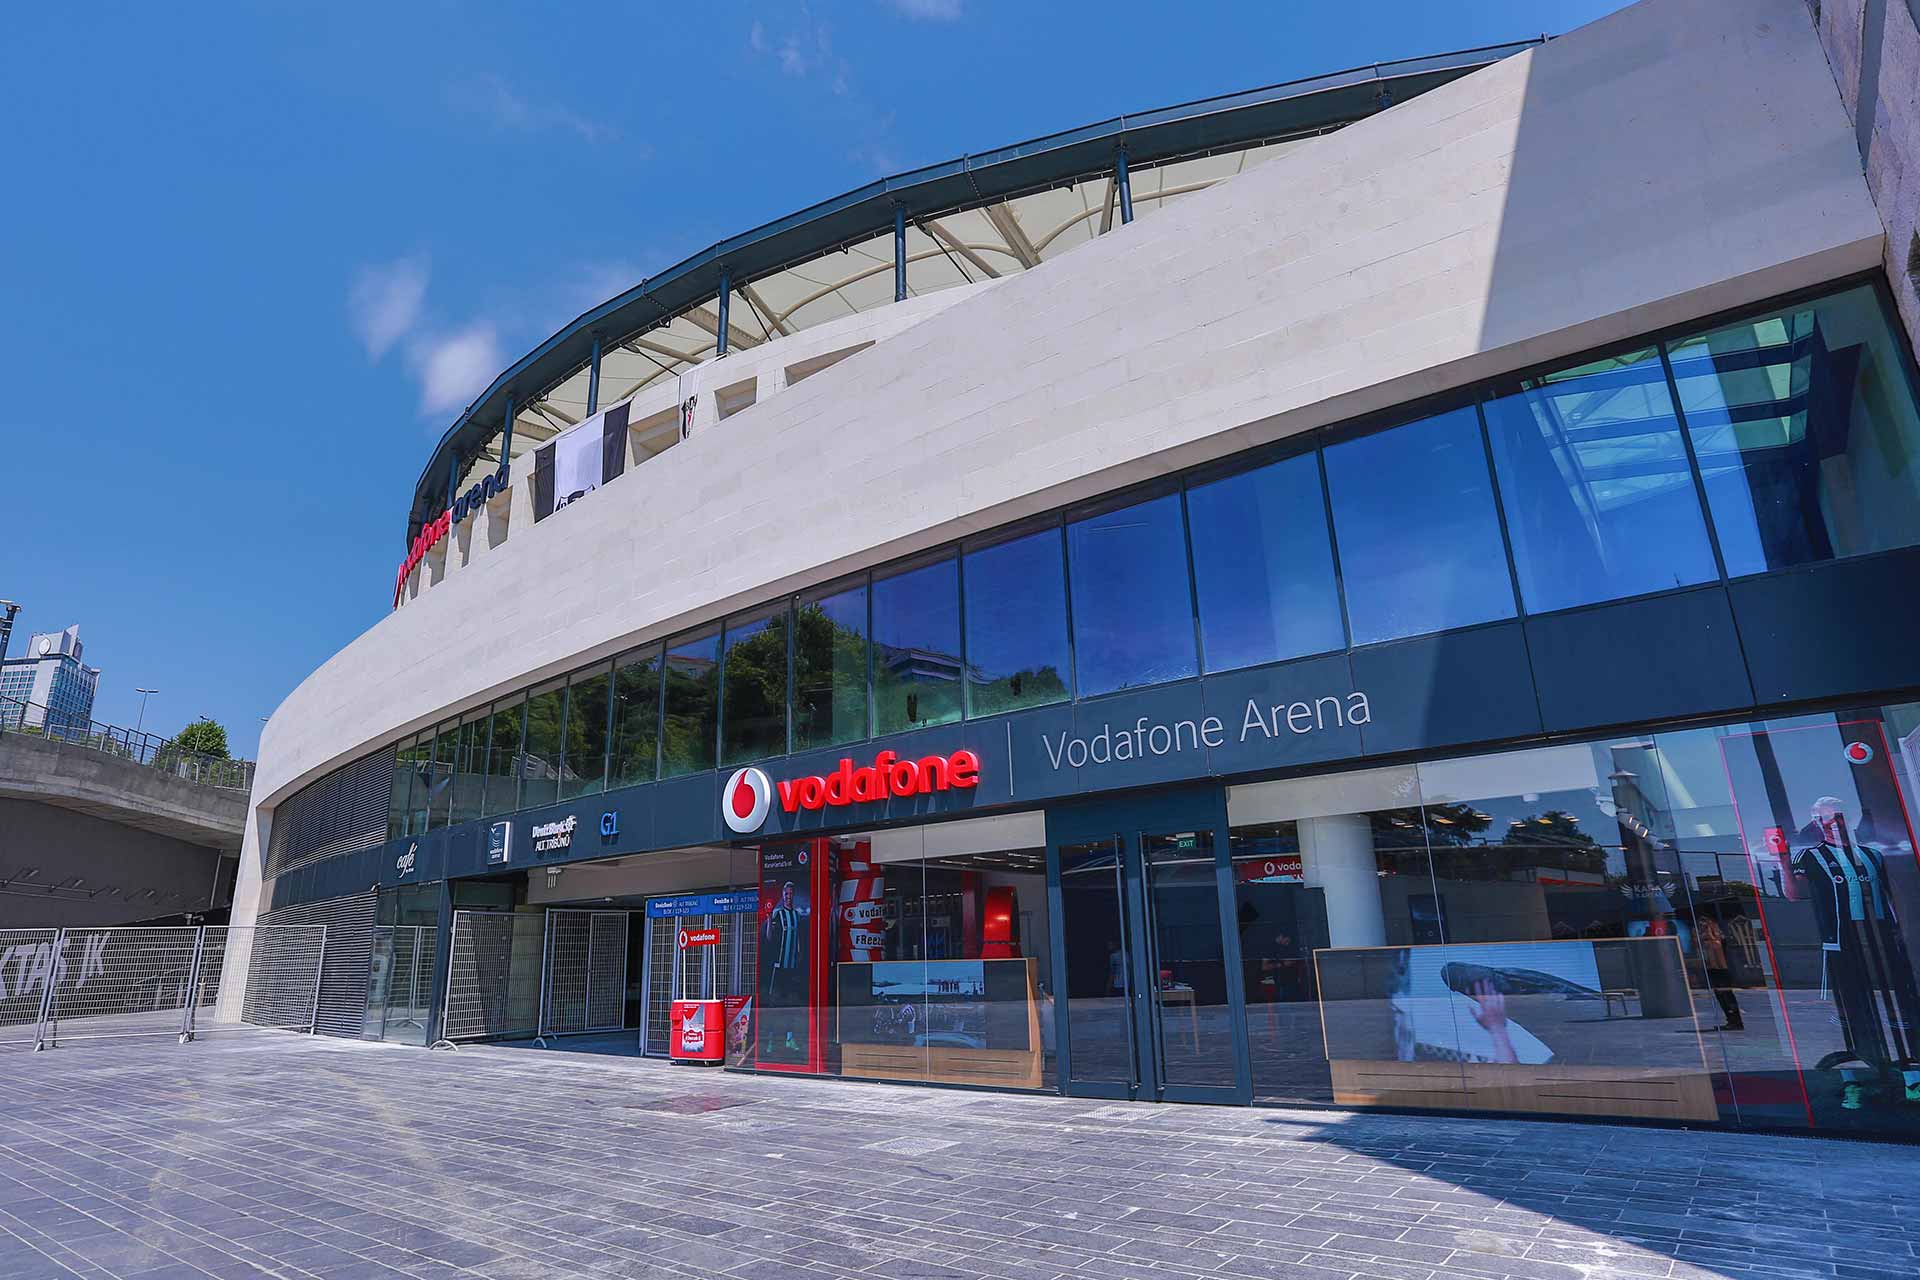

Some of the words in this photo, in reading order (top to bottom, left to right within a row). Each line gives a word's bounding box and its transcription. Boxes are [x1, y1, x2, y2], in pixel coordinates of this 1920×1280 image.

[451, 464, 511, 524] arena
[1043, 716, 1225, 771] Vodafone
[1239, 690, 1373, 743] Arena
[777, 750, 980, 812] vodafone
[600, 811, 620, 836] G1
[396, 842, 418, 879] café
[1179, 840, 1194, 848] EXIT
[690, 934, 716, 942] vodafone
